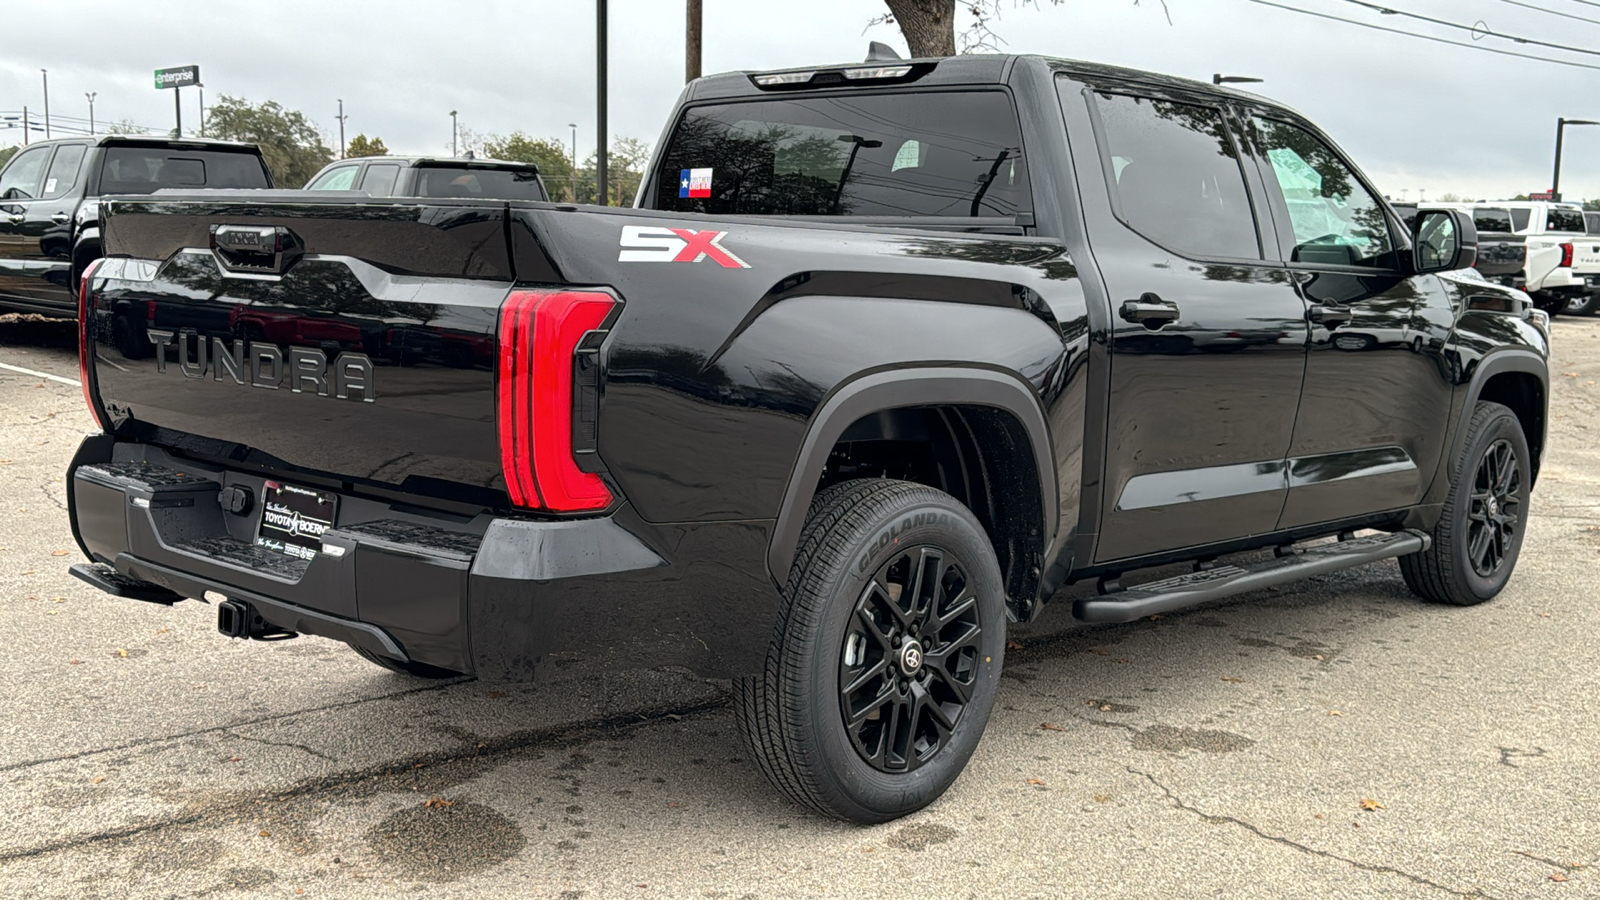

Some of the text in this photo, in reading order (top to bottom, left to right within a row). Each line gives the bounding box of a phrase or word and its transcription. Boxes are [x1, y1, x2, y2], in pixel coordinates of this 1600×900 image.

[156, 69, 194, 84] enterprise
[146, 327, 376, 403] TUNDRA
[265, 512, 290, 526] TOYOTA
